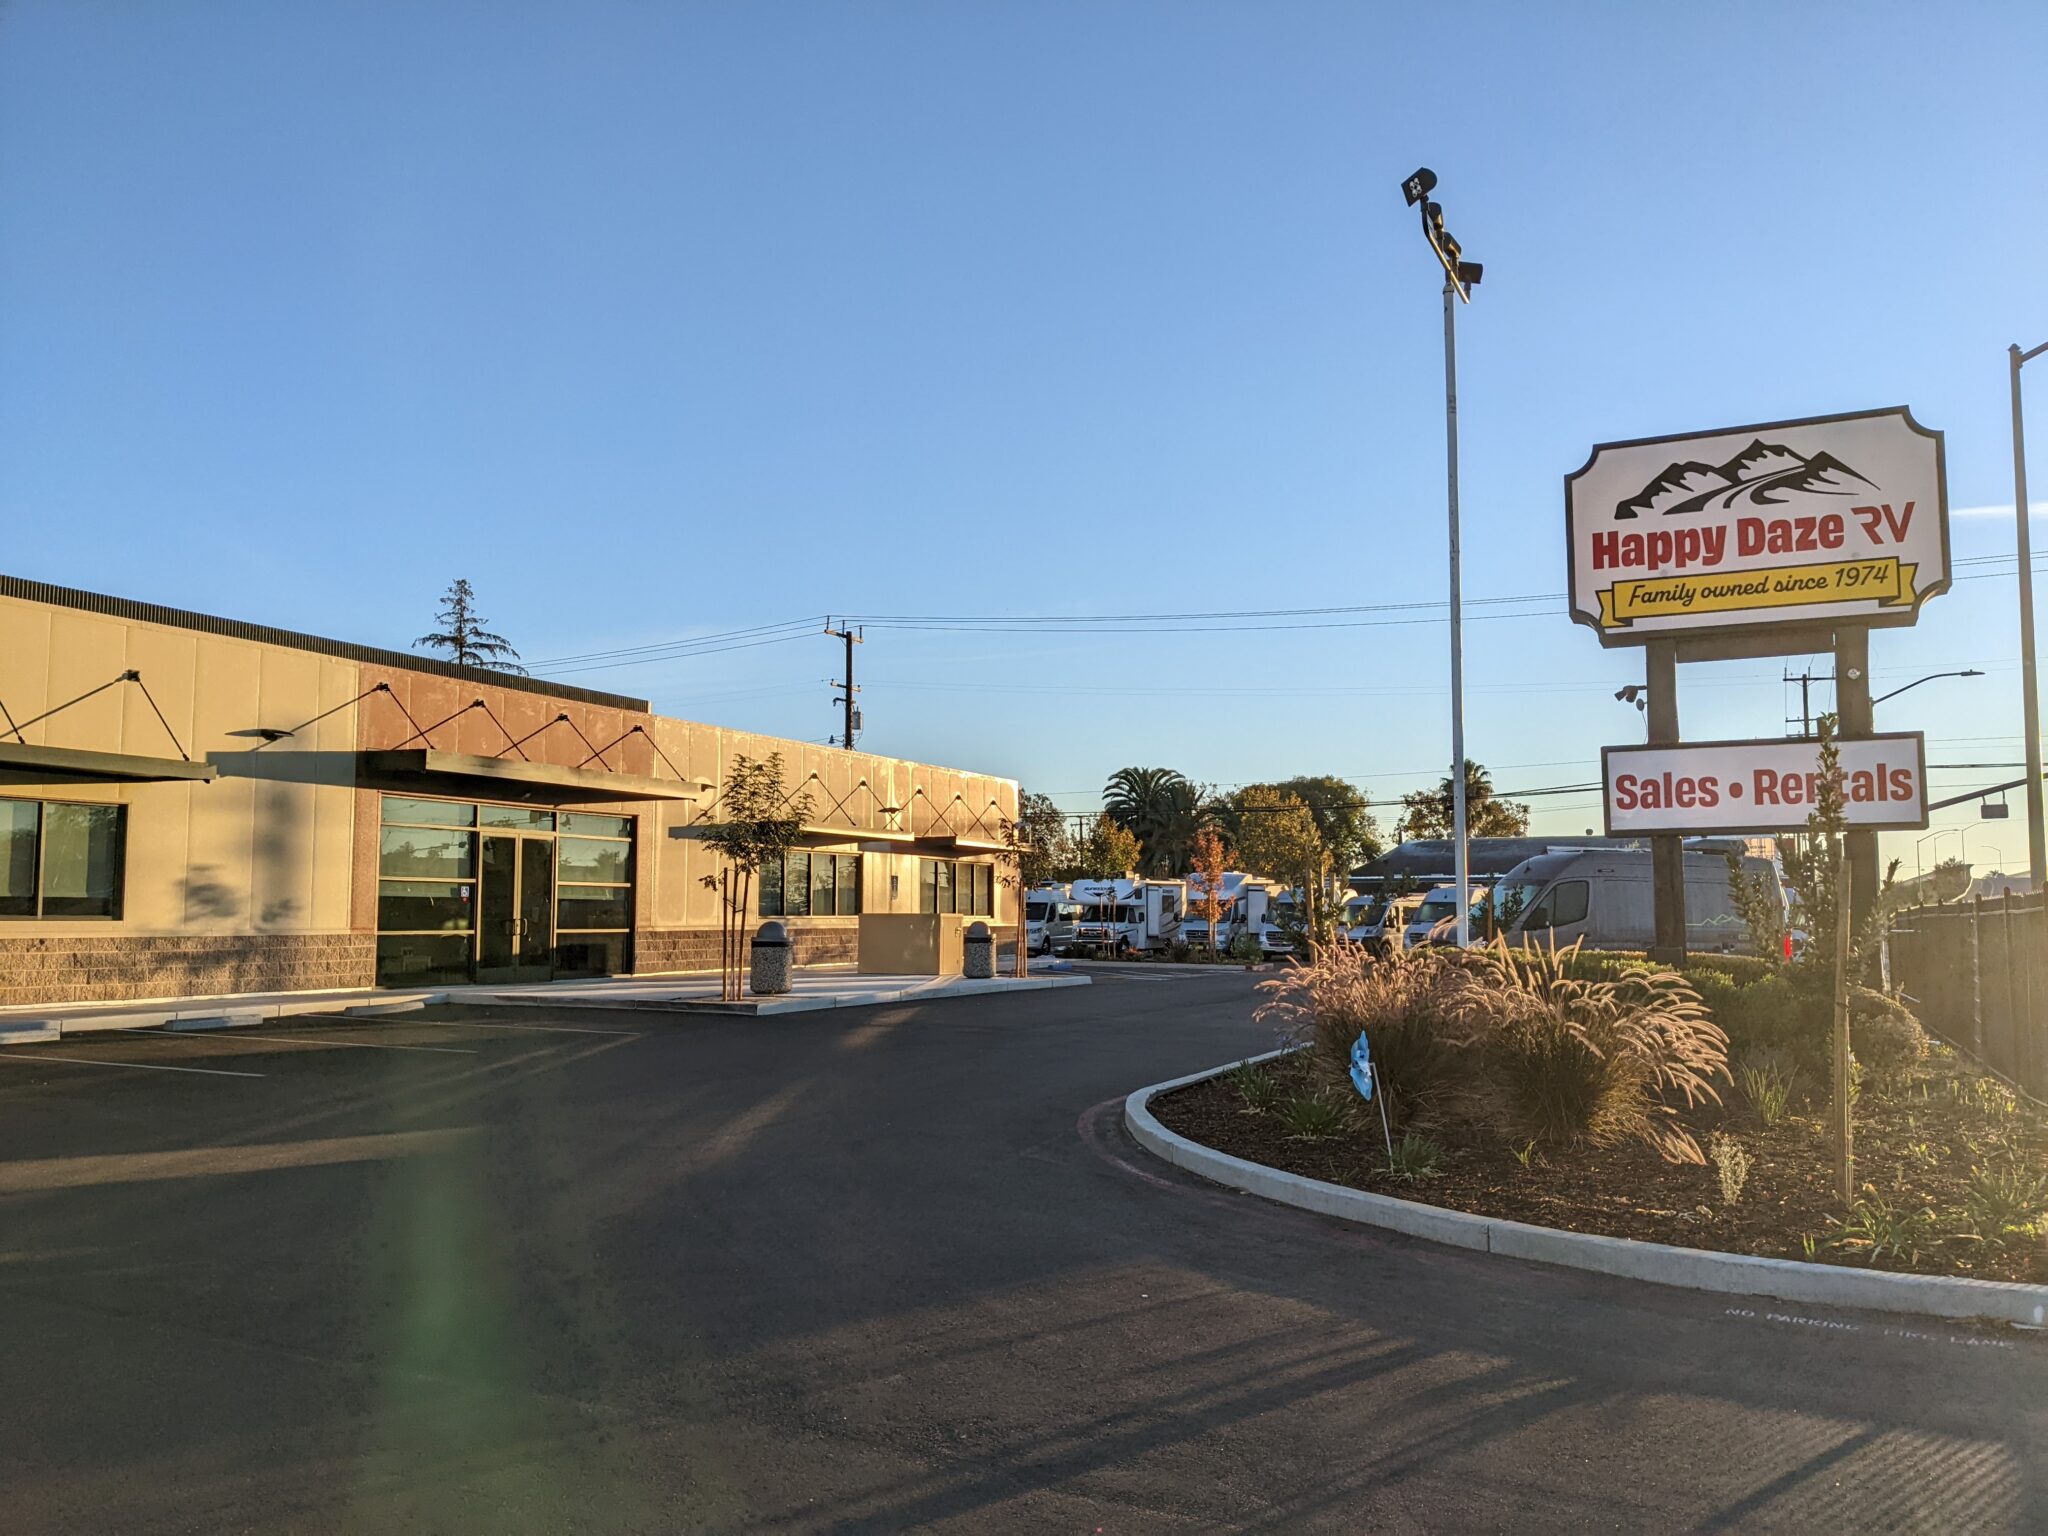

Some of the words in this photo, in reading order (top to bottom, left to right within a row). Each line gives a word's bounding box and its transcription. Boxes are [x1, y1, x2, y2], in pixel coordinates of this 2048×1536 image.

[1592, 525, 1727, 570] Happy
[1737, 514, 1844, 556] Daze
[1851, 501, 1915, 545] RV
[1628, 583, 1696, 607] Family
[1701, 576, 1769, 599] owned
[1773, 574, 1828, 592] since
[1835, 564, 1889, 588] 1974
[1615, 772, 1719, 810] Sales
[1725, 1308, 1755, 1317] NO
[1766, 1313, 1860, 1330] PARKING
